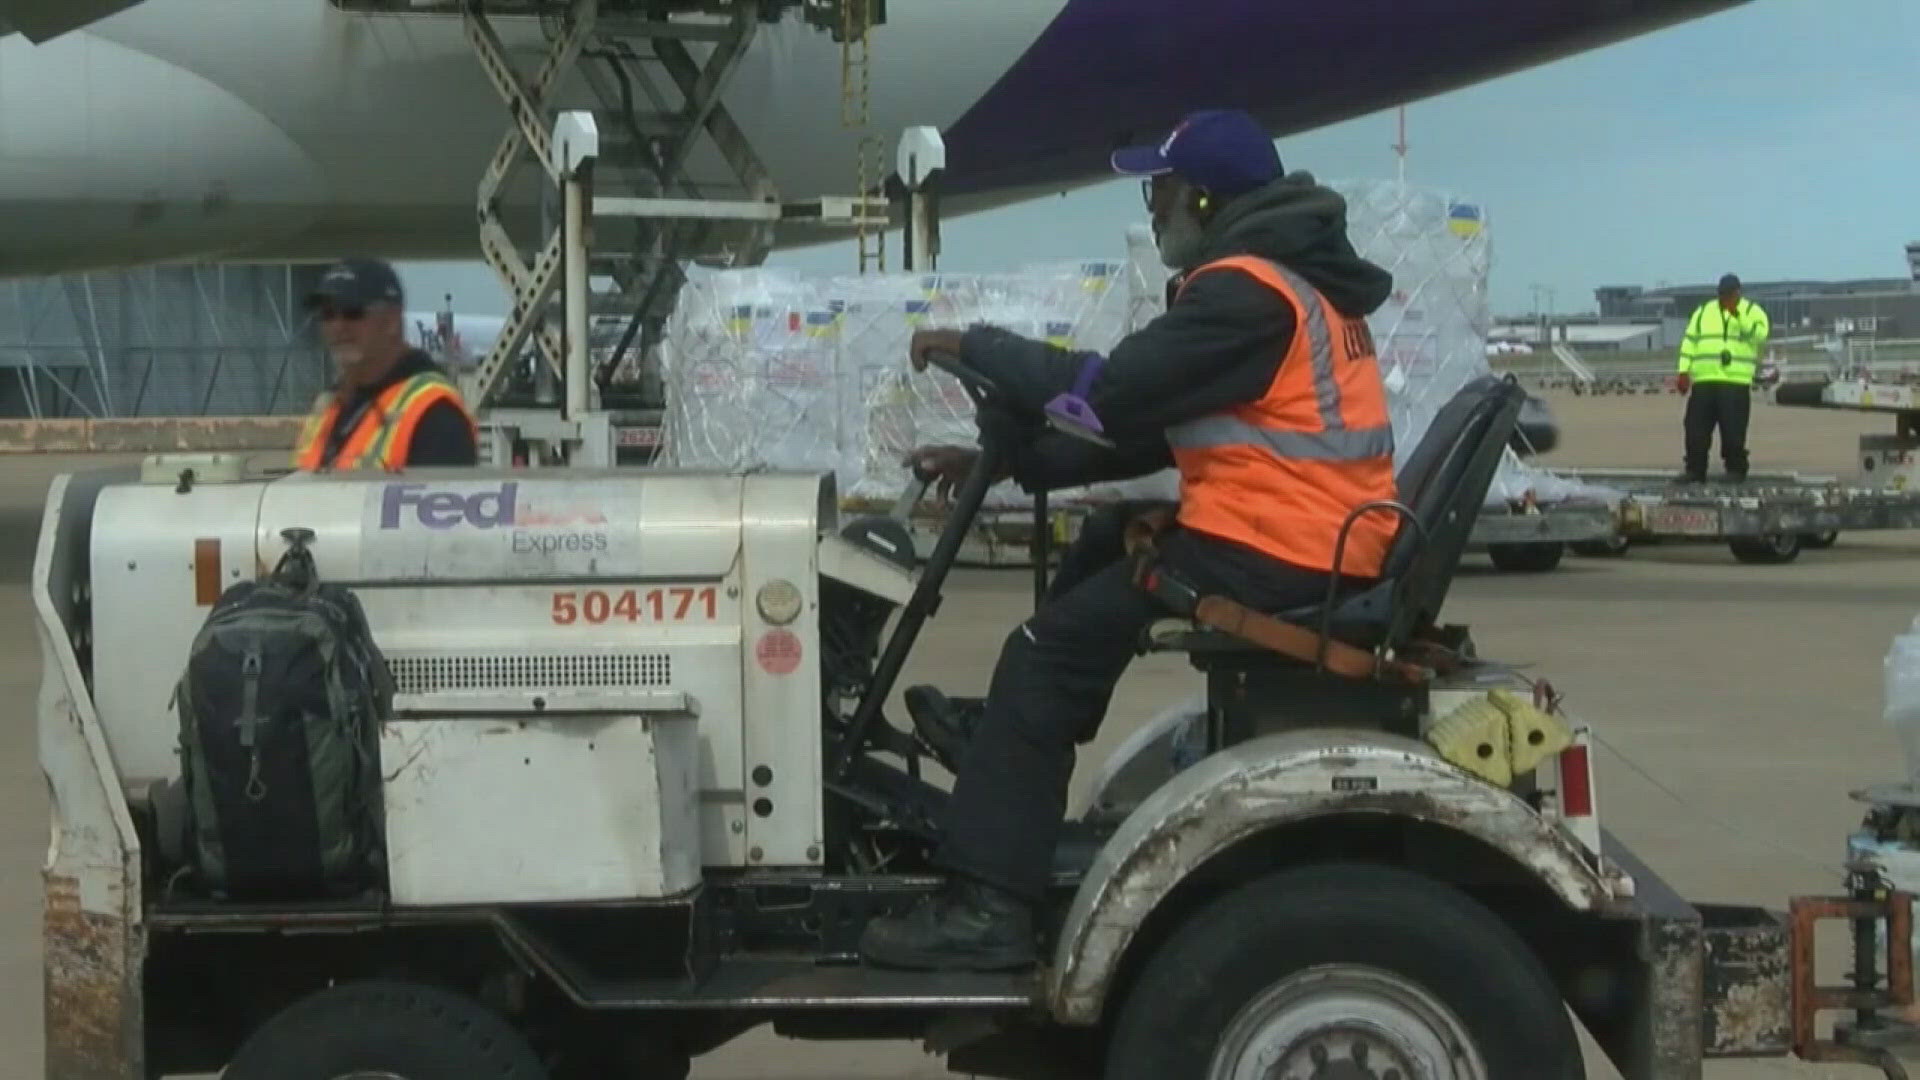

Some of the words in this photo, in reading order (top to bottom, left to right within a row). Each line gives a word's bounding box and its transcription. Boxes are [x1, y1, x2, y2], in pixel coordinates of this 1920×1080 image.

[380, 482, 607, 530] Fed
[512, 531, 607, 554] Express
[552, 588, 716, 625] 504171
